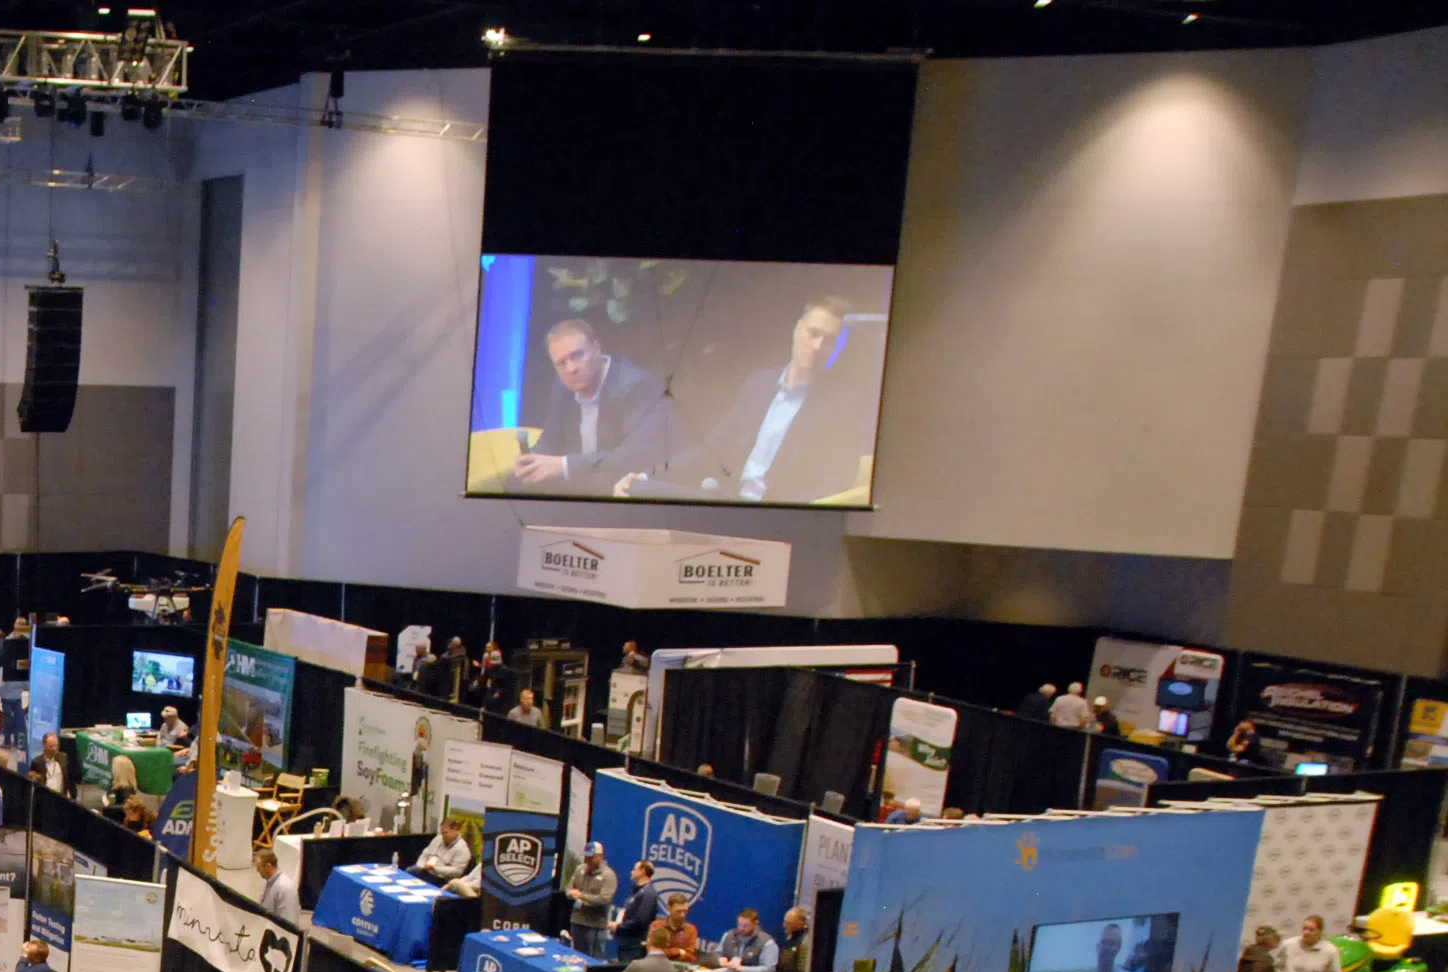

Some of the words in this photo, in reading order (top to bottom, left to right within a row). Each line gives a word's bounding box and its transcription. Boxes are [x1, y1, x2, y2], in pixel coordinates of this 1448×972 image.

[544, 552, 599, 571] BOELTER
[683, 564, 755, 579] BOELTER
[660, 813, 697, 845] AP
[506, 838, 532, 854] AP
[500, 853, 536, 867] SELECT
[649, 843, 702, 876] SELECT
[493, 919, 530, 930] CORN
